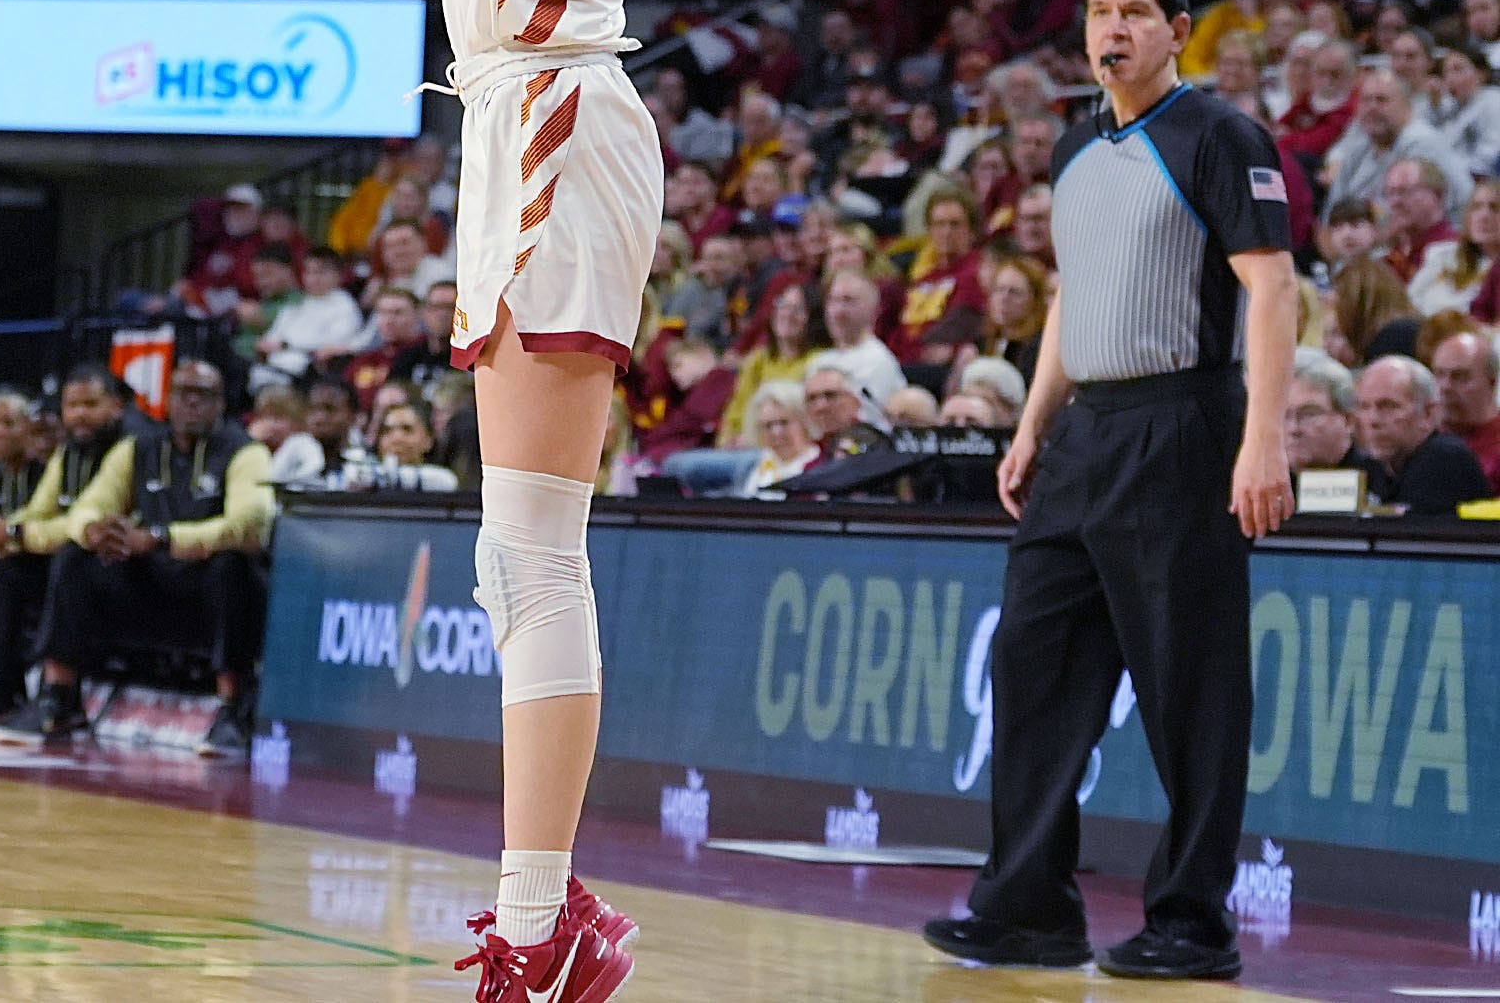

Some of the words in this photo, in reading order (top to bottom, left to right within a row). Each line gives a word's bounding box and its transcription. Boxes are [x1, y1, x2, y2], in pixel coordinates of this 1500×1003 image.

[156, 60, 316, 99] HISOY
[317, 600, 398, 668] IOWA
[755, 569, 963, 753] CORN
[1247, 591, 1469, 813] OWA
